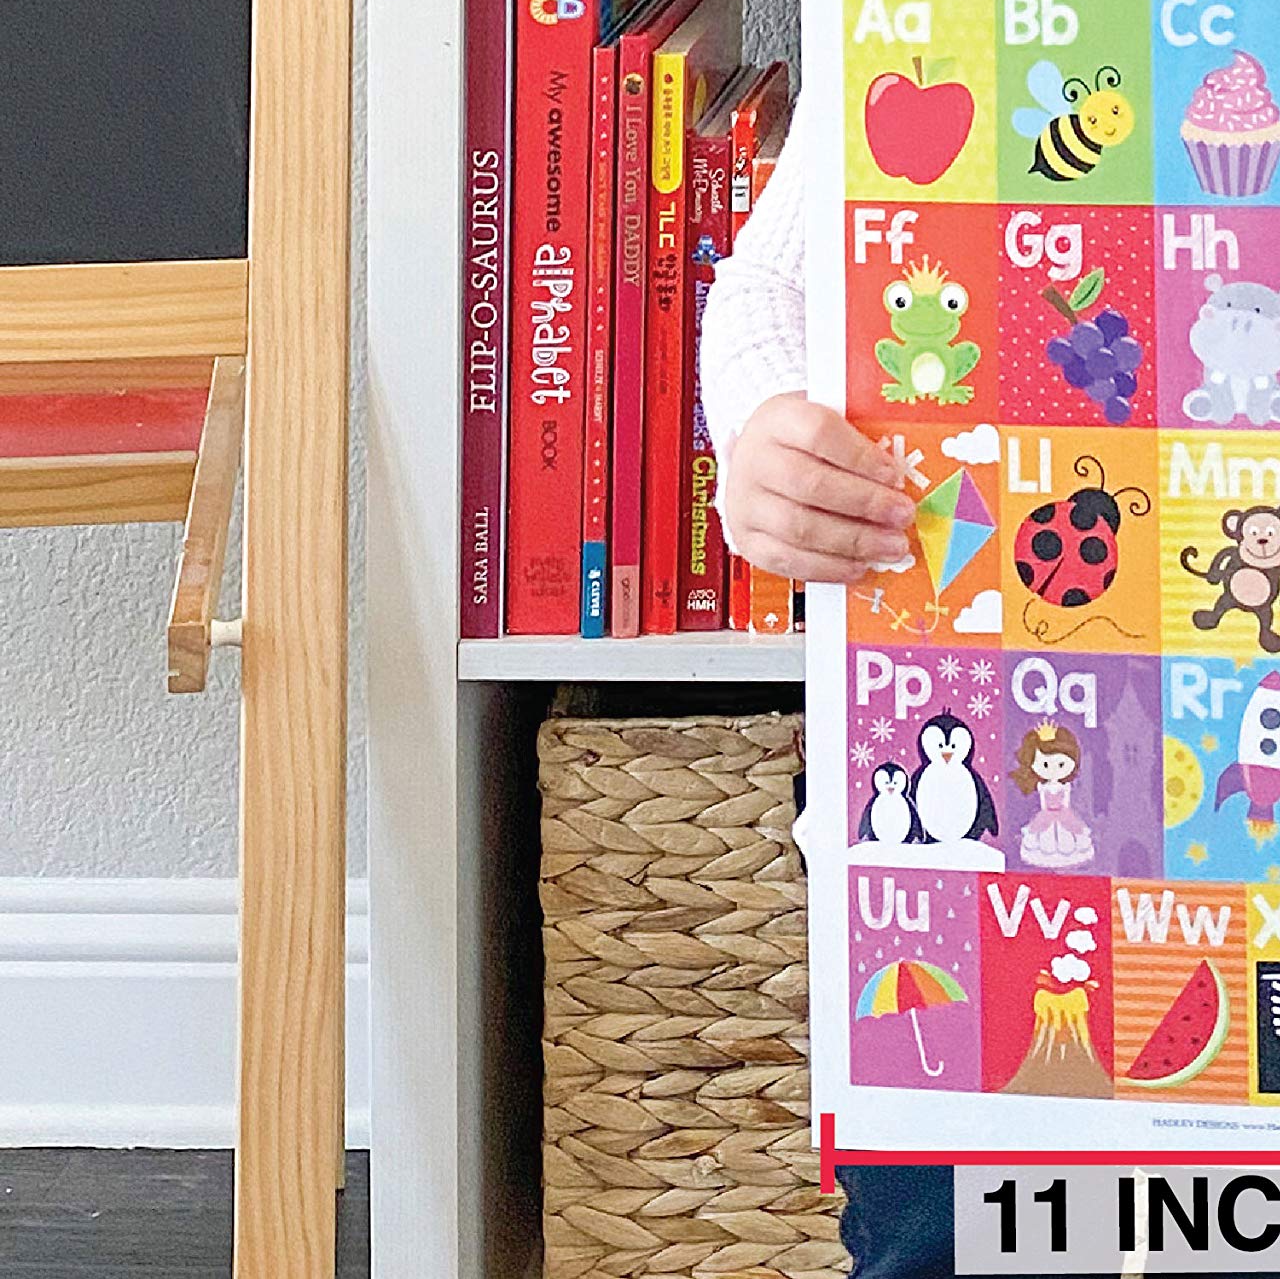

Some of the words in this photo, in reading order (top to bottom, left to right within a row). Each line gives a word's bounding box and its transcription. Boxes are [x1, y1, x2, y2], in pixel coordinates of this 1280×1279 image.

[542, 70, 569, 104] My
[625, 119, 642, 161] Love
[546, 110, 563, 233] awesome
[623, 215, 641, 287] DADDY
[853, 209, 916, 266] Ff
[1005, 212, 1083, 278] Gg
[1162, 214, 1240, 271] Hh
[470, 150, 499, 413] FLIP-O-SAURUS
[531, 243, 575, 405] alphabet
[540, 419, 558, 471] BOOK
[1008, 437, 1052, 494] Ll
[475, 506, 488, 550] BALL
[692, 456, 717, 575] Christmas
[473, 552, 487, 604] SARA
[688, 599, 717, 611] HMH
[855, 651, 932, 720] Pp
[1011, 658, 1097, 728] Qq
[1171, 662, 1240, 717] Rr
[859, 877, 931, 933] Uu
[986, 884, 1066, 943] Vv
[1119, 890, 1230, 946] Ww
